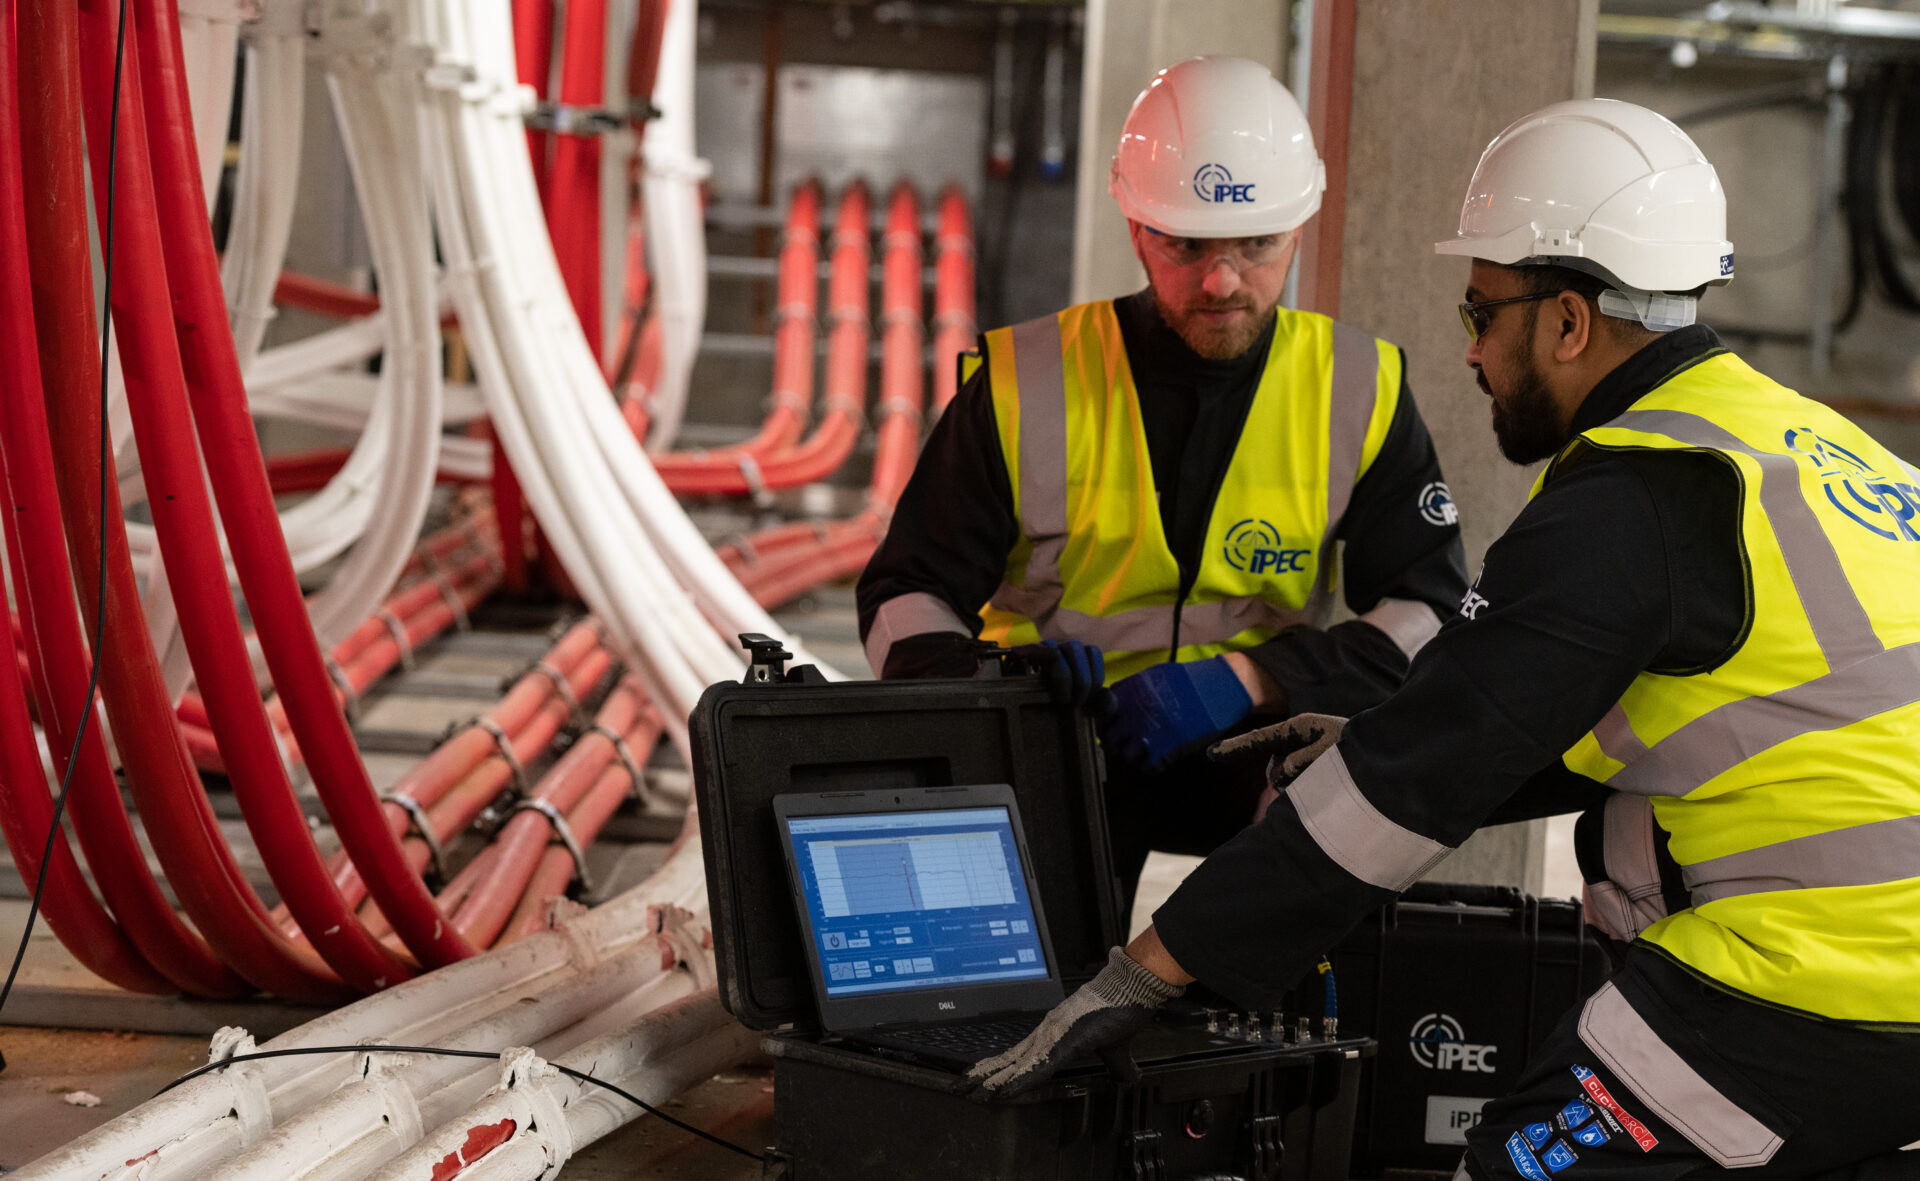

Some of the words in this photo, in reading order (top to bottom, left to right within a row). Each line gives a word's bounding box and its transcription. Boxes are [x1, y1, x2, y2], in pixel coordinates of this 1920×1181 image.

[938, 1001, 956, 1011] DELL
[1588, 1081, 1616, 1112] CLICK
[1642, 1139, 1653, 1147] 6
